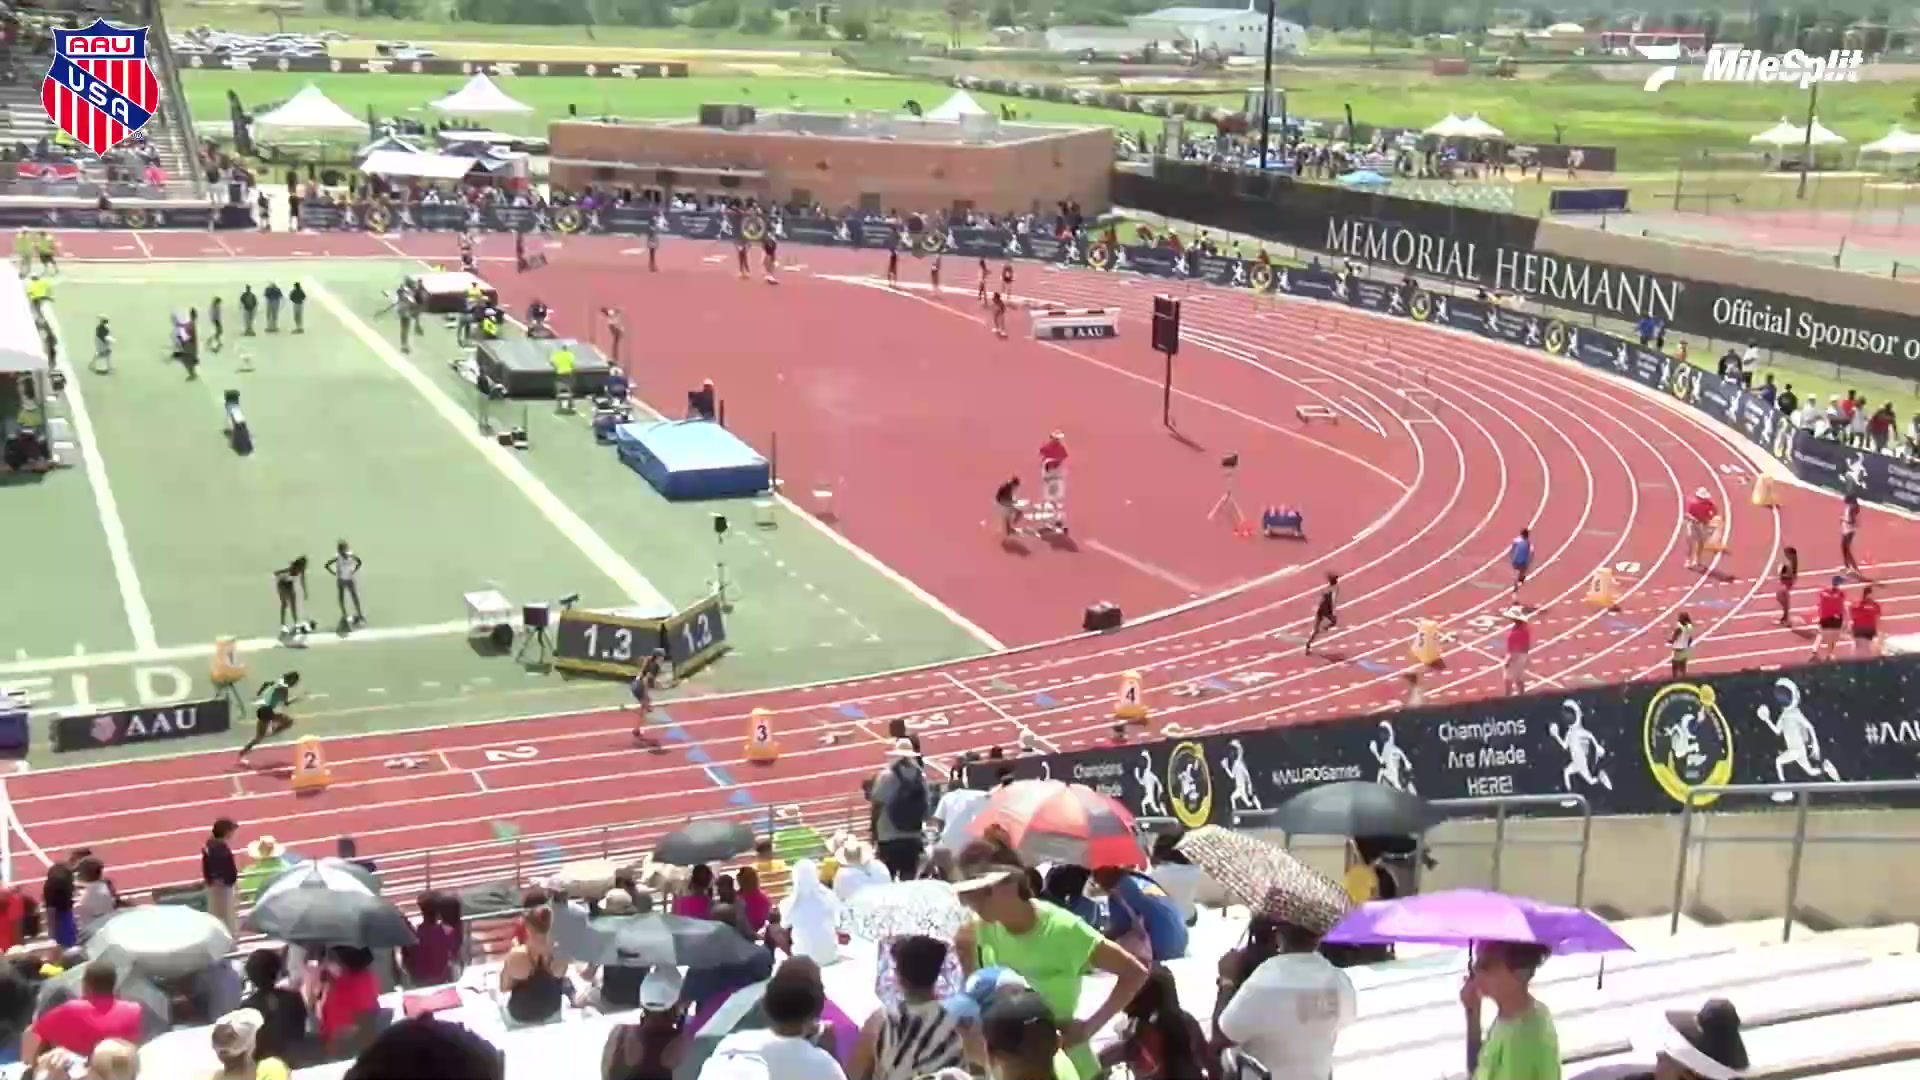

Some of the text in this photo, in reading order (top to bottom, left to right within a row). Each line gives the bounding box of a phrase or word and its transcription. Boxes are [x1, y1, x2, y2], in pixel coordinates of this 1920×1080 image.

[1326, 216, 1679, 322] MEMORIAL HERMANN
[1713, 297, 1791, 336] Official
[1796, 312, 1899, 356] Sponsor
[584, 623, 633, 661] 1.3
[1125, 686, 1136, 704] 4
[127, 707, 198, 738] AAU
[756, 724, 769, 743] 3
[1438, 716, 1527, 744] Champions
[303, 751, 318, 770] 2
[1447, 744, 1527, 769] Are Made
